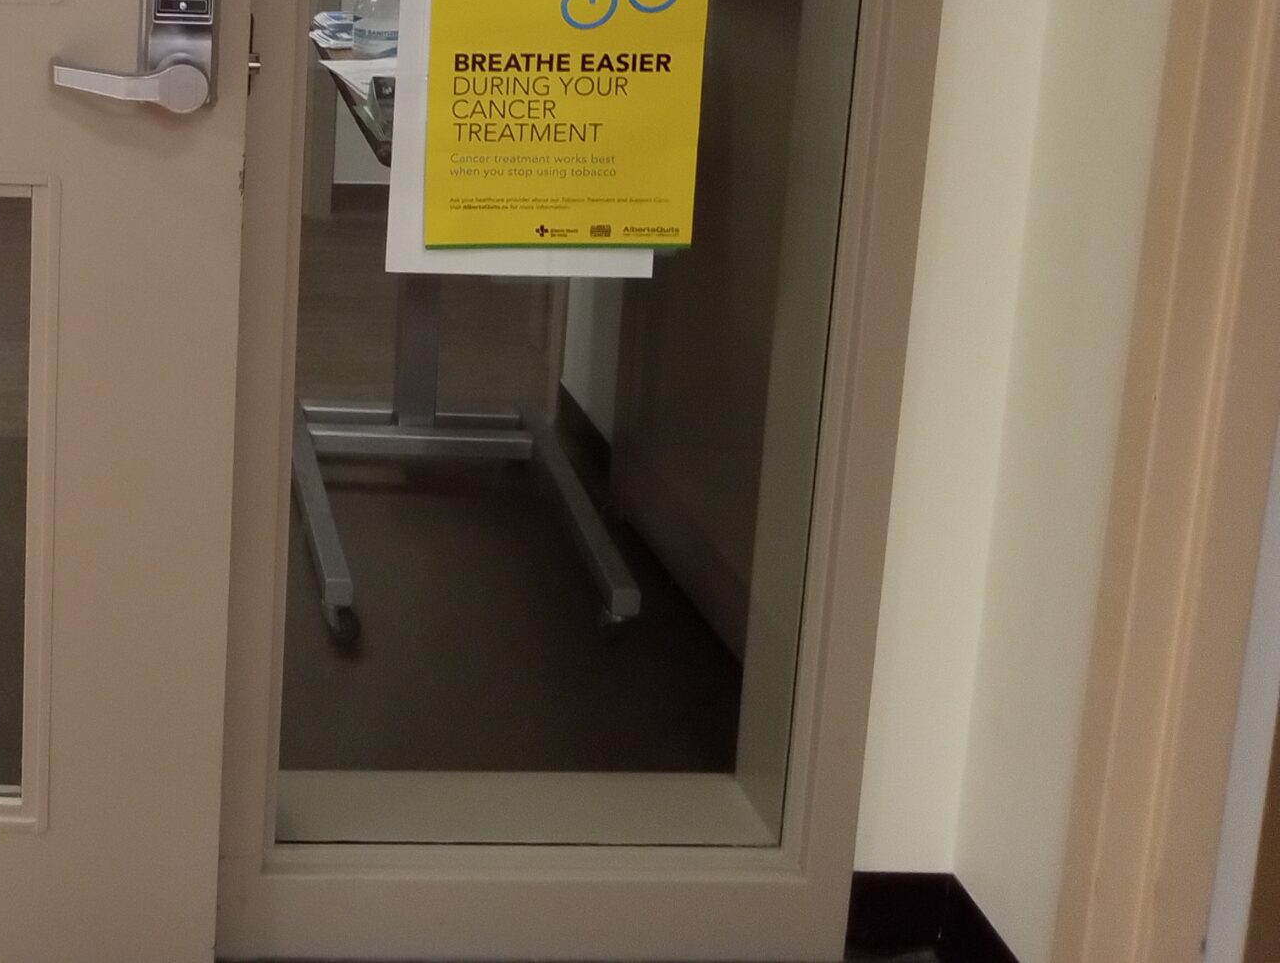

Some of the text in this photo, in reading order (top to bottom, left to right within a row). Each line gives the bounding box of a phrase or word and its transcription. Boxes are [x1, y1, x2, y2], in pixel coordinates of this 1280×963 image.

[454, 53, 671, 73] BREATHE EASIER
[453, 76, 629, 97] DURING YOUR
[451, 99, 557, 120] CANCER
[453, 122, 604, 143] TREATMENT
[450, 153, 616, 165] Cancer treatment works best
[449, 166, 617, 180] when you stop using tobacco
[623, 226, 680, 234] AlbertaQuits
